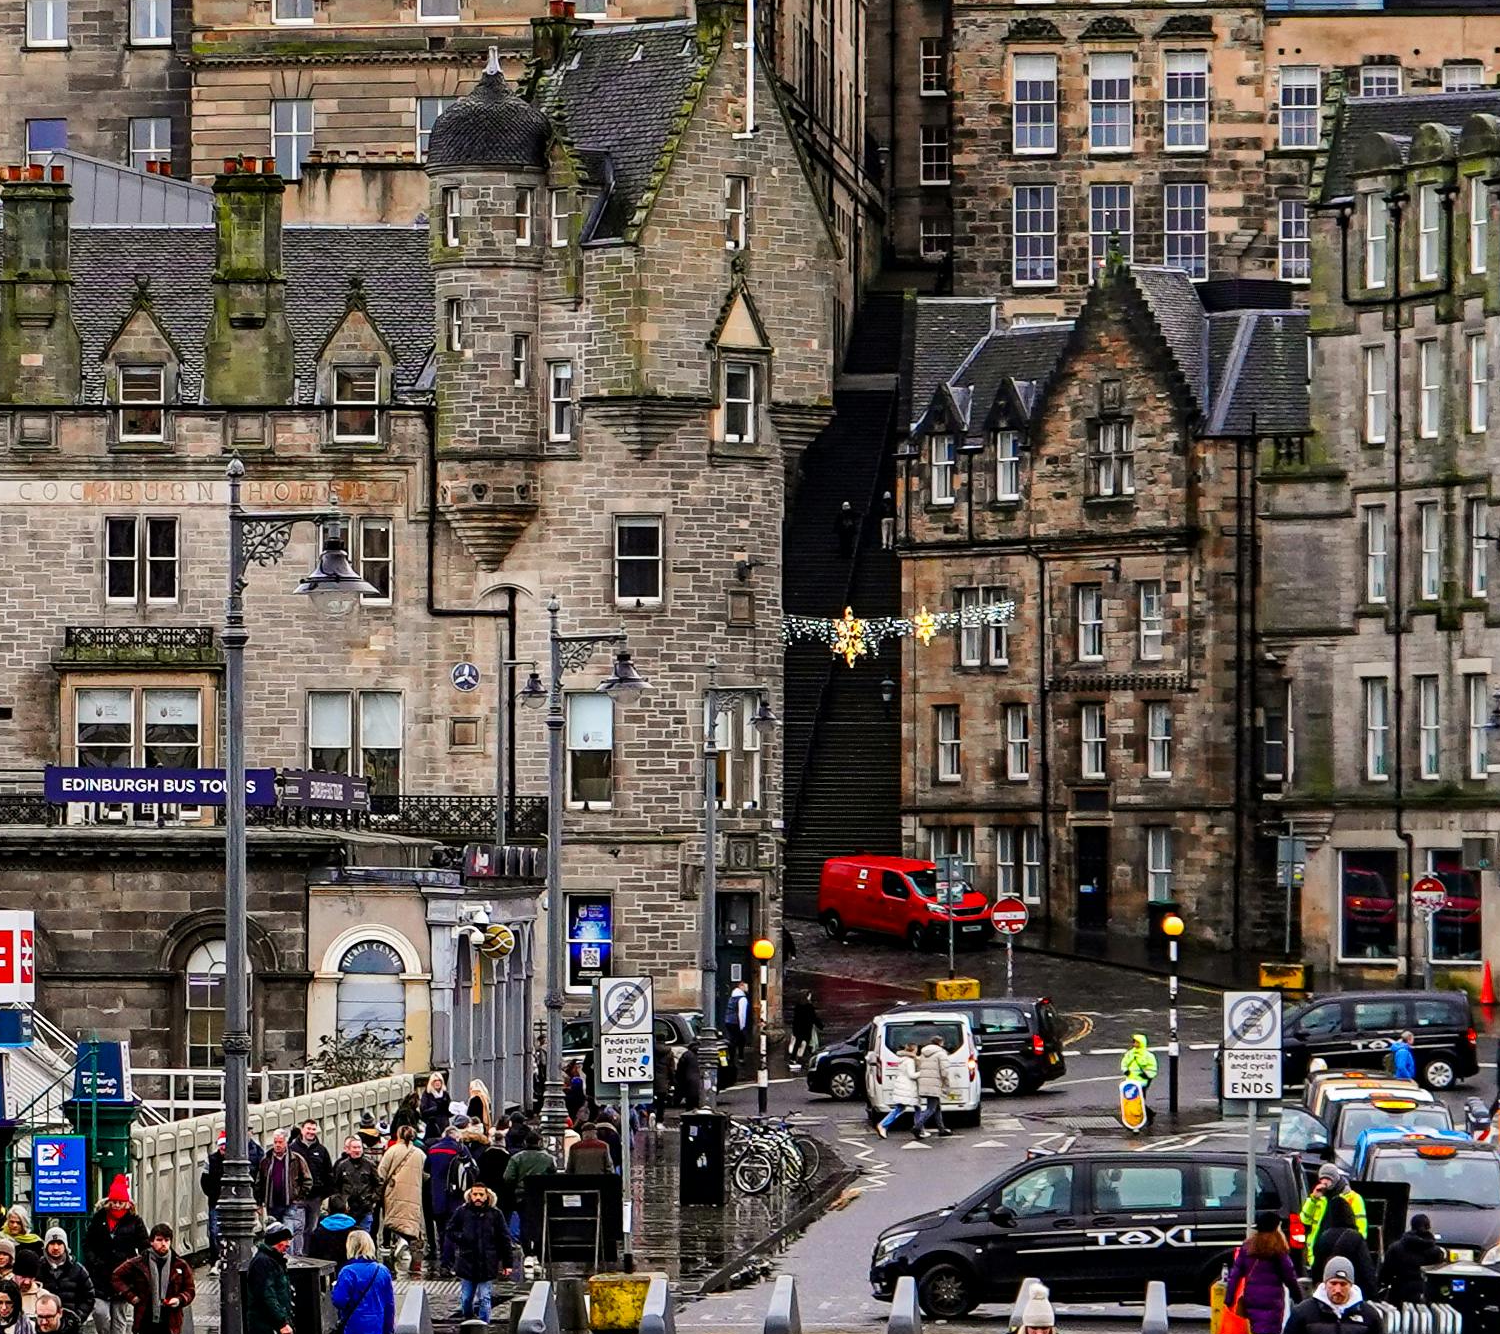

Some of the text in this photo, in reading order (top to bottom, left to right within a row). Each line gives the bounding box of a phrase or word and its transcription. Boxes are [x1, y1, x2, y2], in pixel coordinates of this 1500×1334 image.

[62, 777, 256, 794] EDINBURGH BUS TOUS
[604, 1037, 650, 1045] Pedestrian
[607, 1046, 647, 1056] and cycle
[1228, 1052, 1278, 1060] Pedestrian
[616, 1055, 638, 1064] Zone
[1230, 1061, 1274, 1071] and cycle
[1241, 1071, 1263, 1080] Zone
[1231, 1082, 1274, 1094] ENDS
[1086, 1226, 1192, 1248] TAXI
